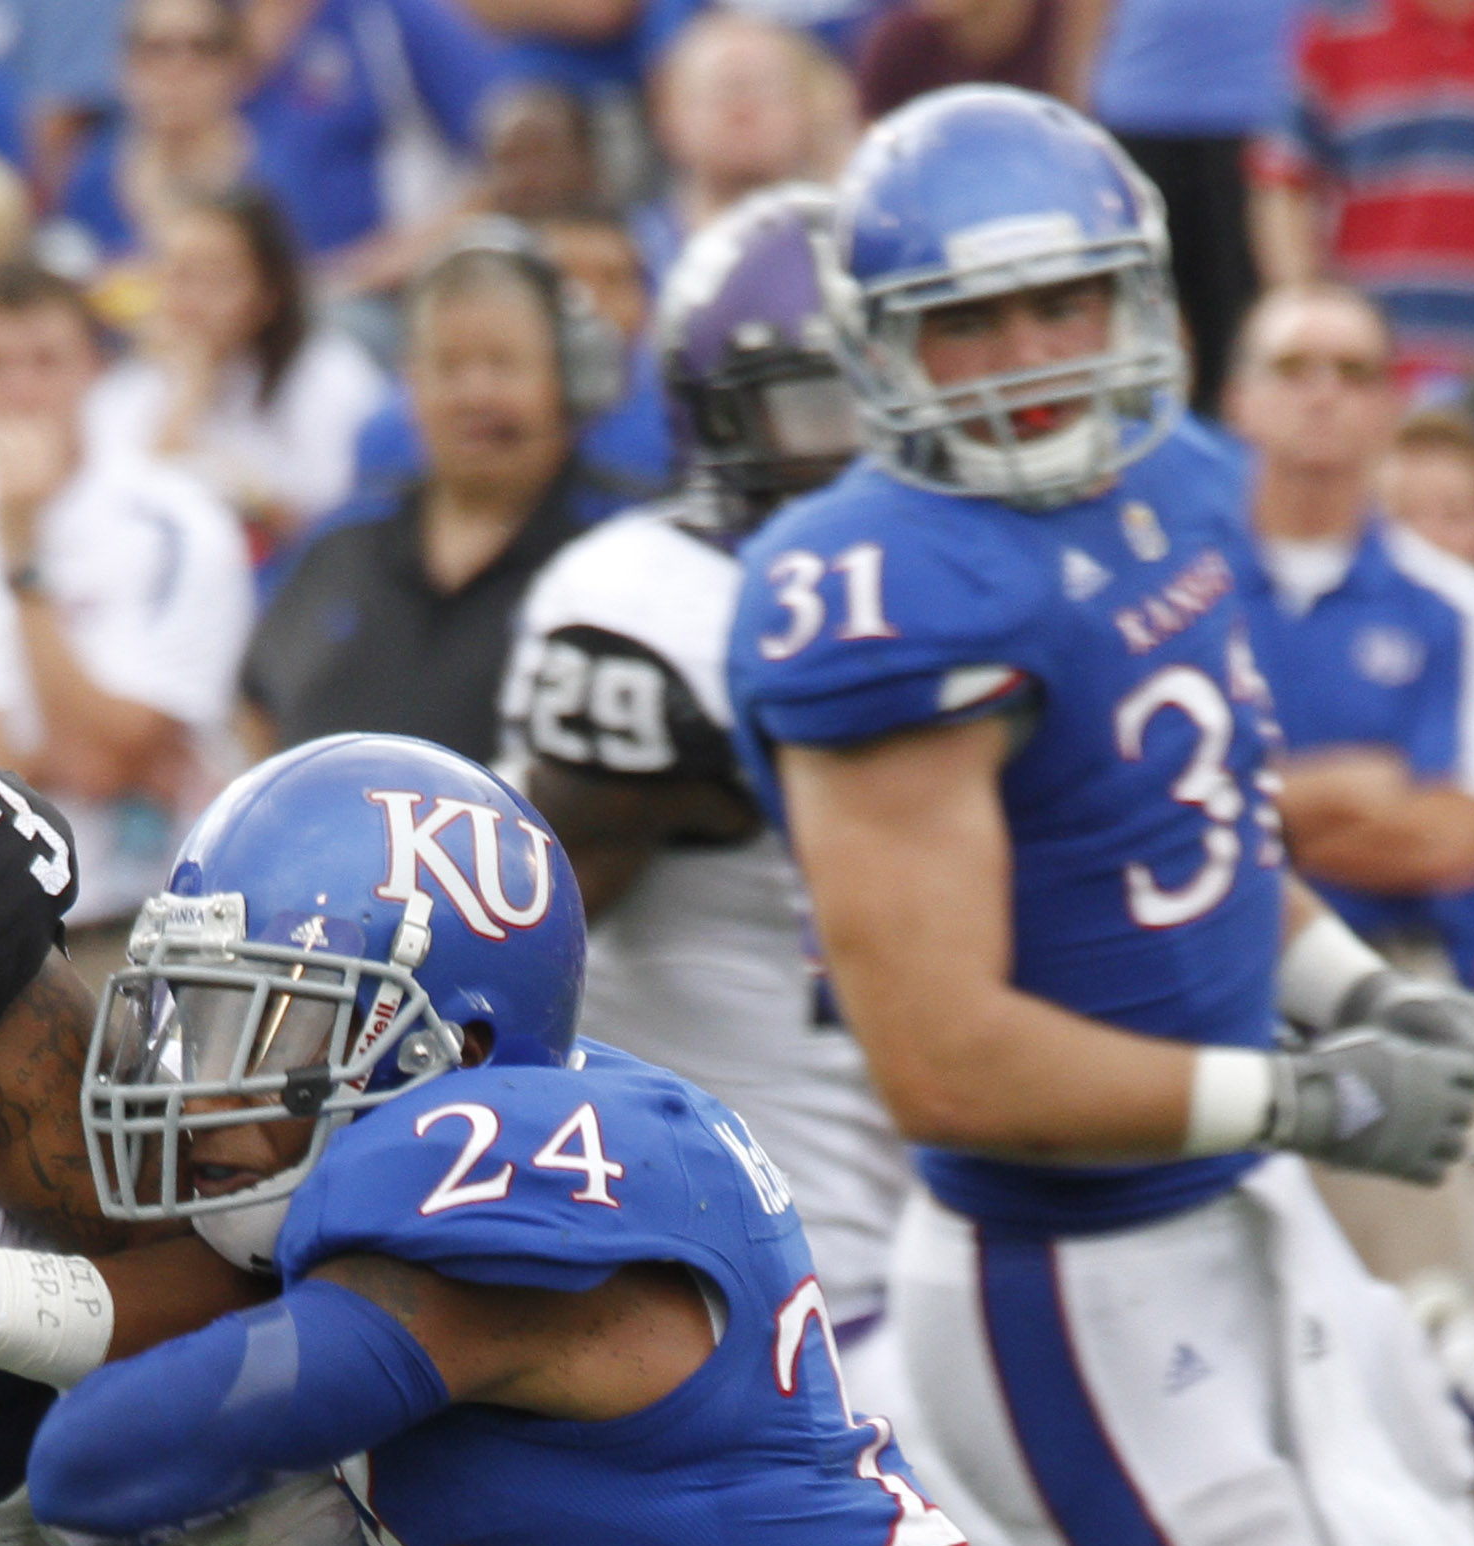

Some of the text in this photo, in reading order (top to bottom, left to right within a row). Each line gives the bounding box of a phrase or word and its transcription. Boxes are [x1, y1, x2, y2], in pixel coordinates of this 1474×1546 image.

[759, 543, 899, 662] 31
[527, 641, 677, 773] 29
[369, 790, 554, 941] KU
[414, 1101, 624, 1216] 24
